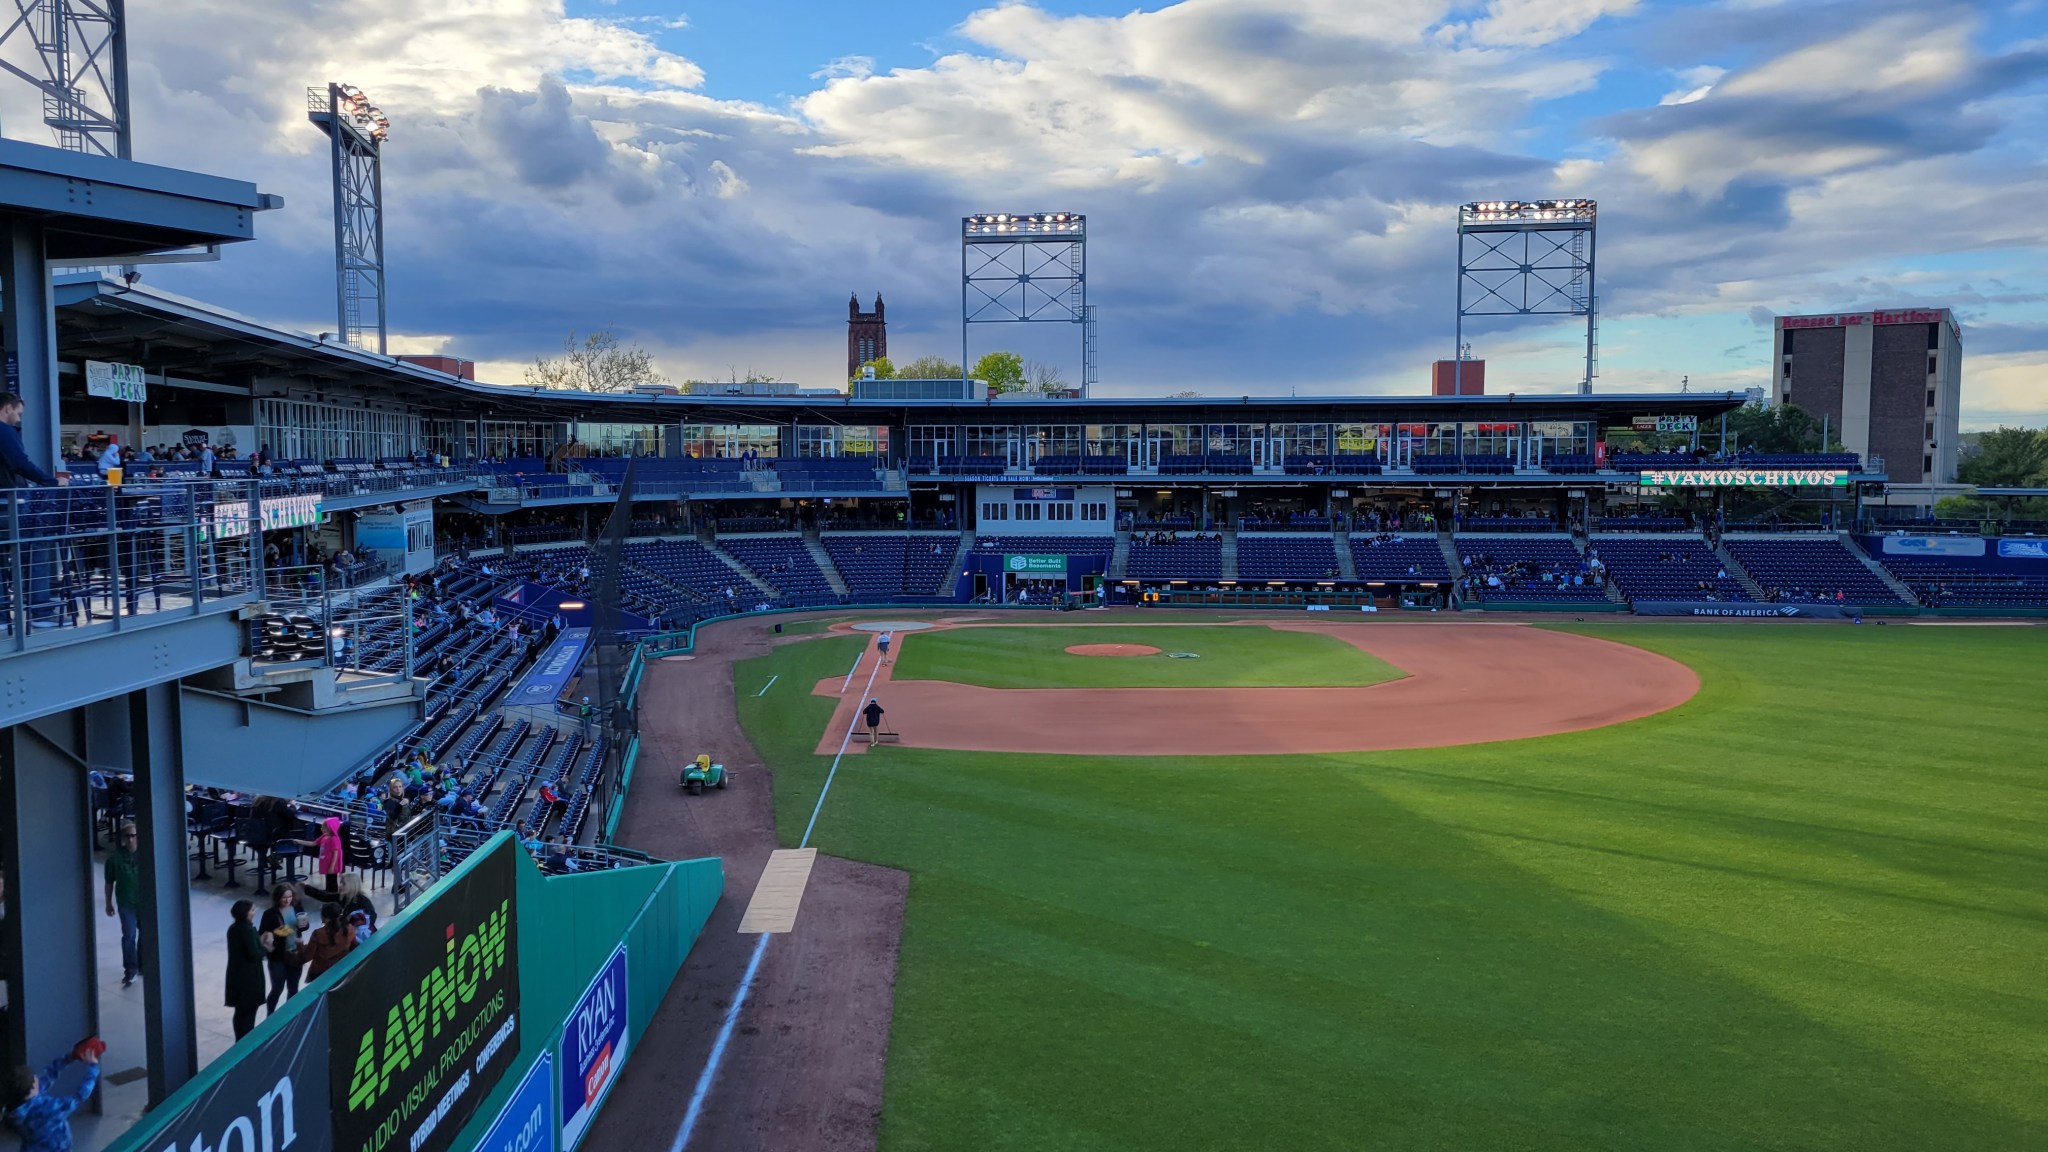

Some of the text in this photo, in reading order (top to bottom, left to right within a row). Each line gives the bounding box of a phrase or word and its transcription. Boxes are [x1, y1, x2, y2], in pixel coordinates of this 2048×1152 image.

[110, 363, 143, 382] PARTY
[113, 381, 145, 400] DECK!
[1658, 415, 1695, 423] PARTY
[1651, 470, 1836, 485] #VAMOSCHIVOS
[578, 967, 615, 1062] RYAN
[361, 989, 504, 1152] AUDIO VISUAL PRODUCTIONS
[409, 1013, 515, 1152] HYBRID MEETINGS CONFERENCES
[587, 1056, 609, 1097] Canon
